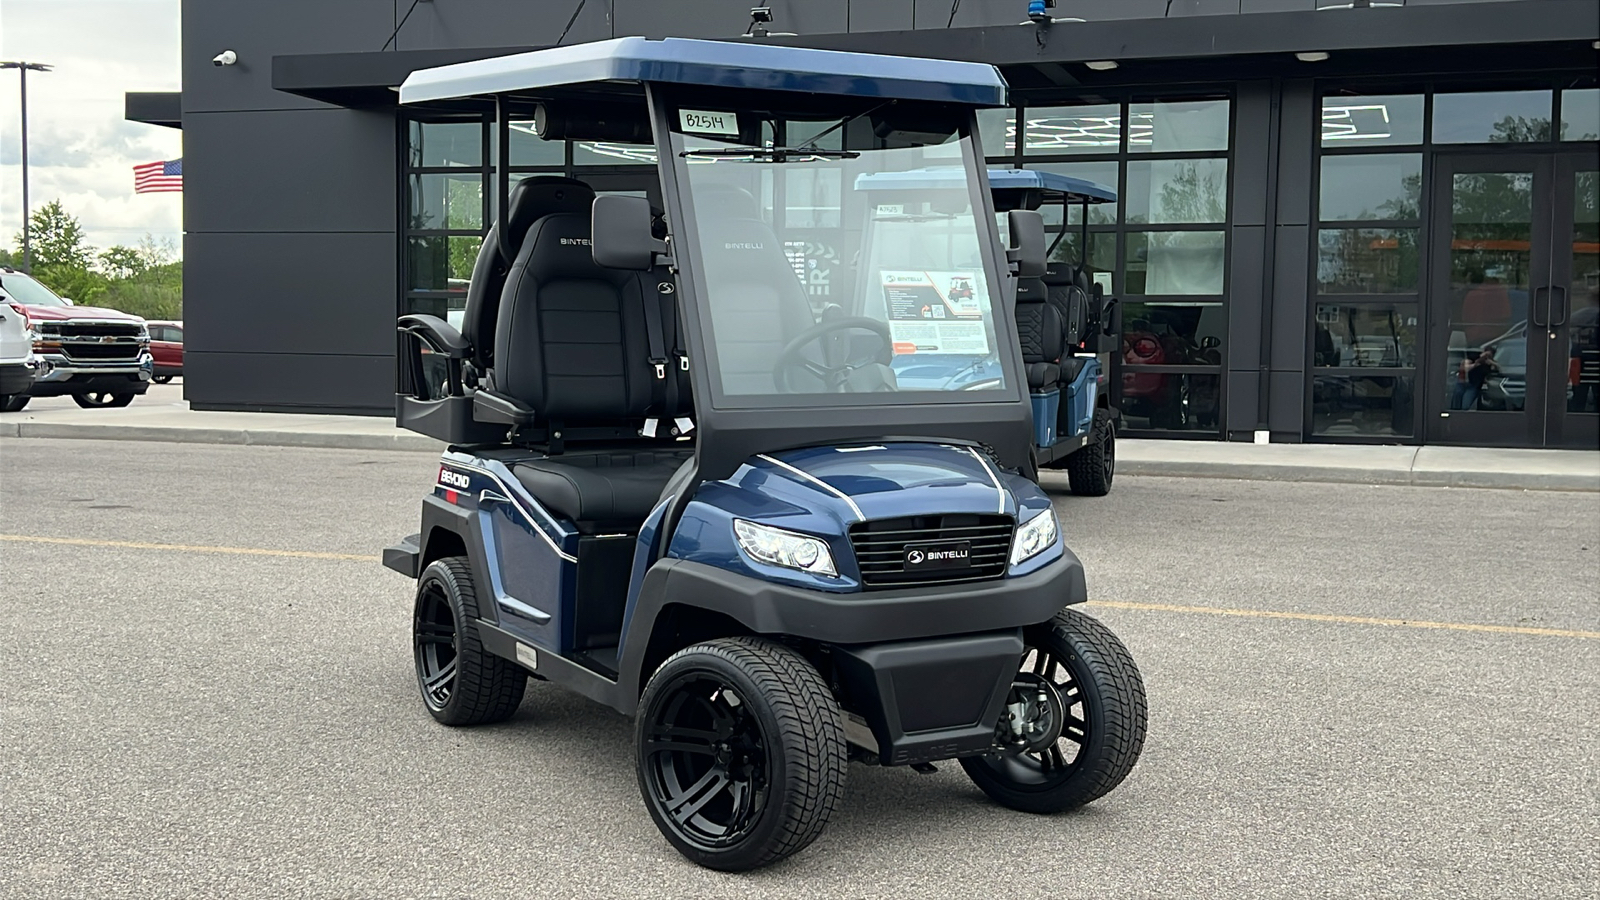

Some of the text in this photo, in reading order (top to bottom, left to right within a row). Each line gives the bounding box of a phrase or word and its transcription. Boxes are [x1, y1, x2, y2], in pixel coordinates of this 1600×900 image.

[686, 114, 724, 129] B2514
[560, 238, 593, 246] BINTEL
[440, 469, 470, 488] BEYOND
[927, 550, 968, 560] BINTELLI
